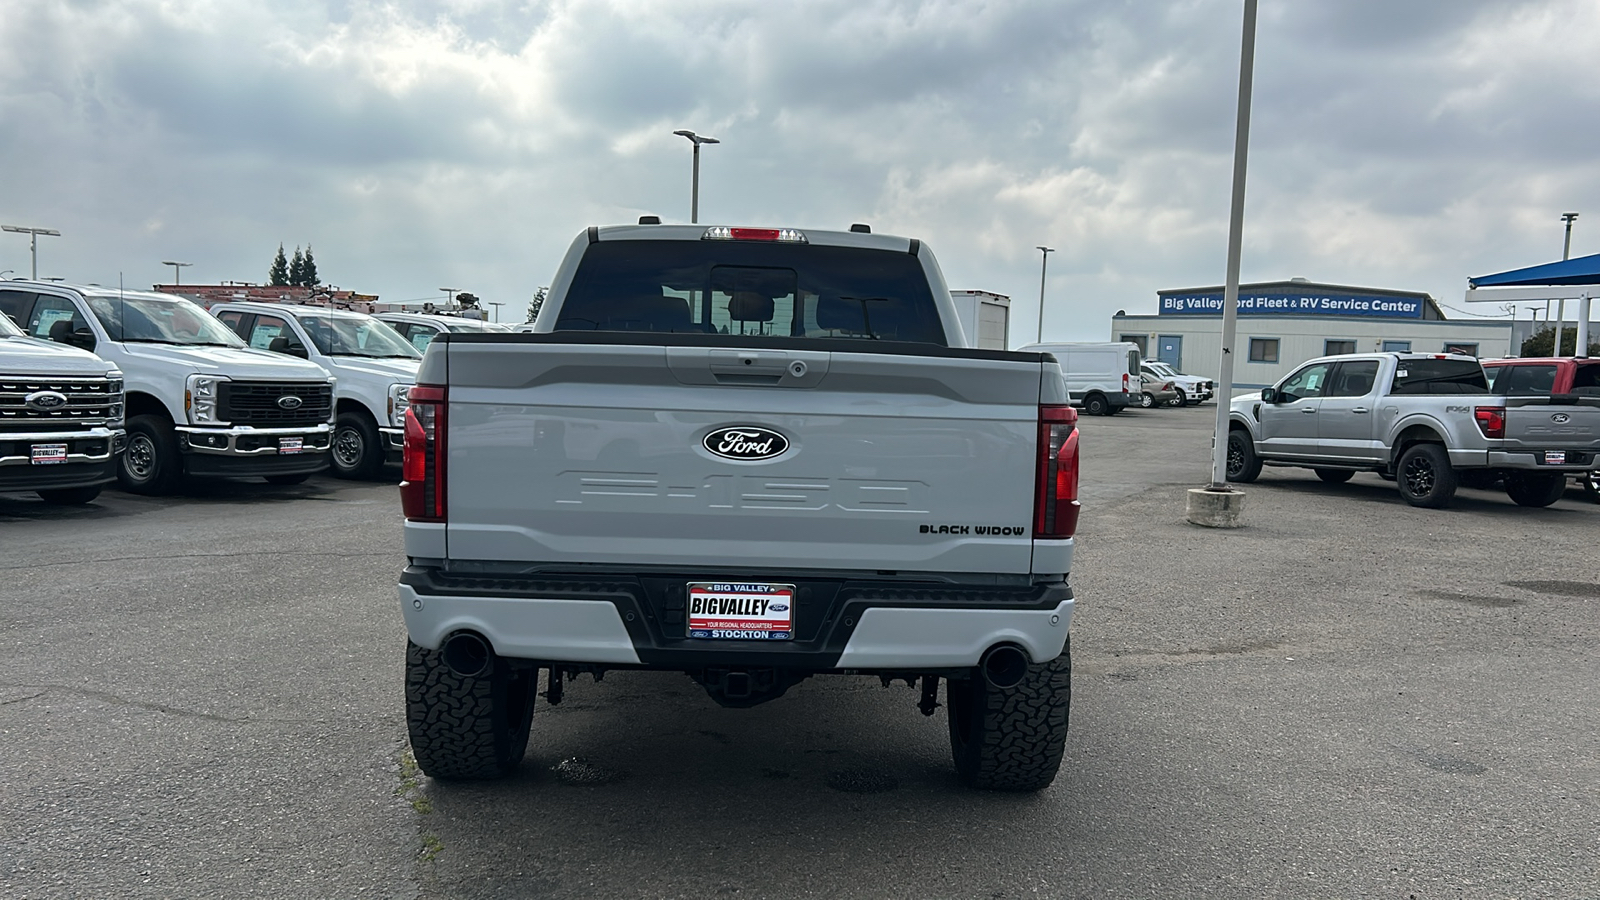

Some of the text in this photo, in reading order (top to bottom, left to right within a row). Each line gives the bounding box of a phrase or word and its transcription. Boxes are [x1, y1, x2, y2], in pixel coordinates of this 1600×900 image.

[1164, 298, 1184, 310] Big
[1186, 298, 1224, 310] Valley
[1236, 297, 1254, 308] ord
[1256, 297, 1288, 308] Fleet
[1300, 298, 1319, 308] RV
[1321, 298, 1369, 310] Service
[1371, 300, 1417, 312] Center
[39, 396, 58, 406] Ford
[718, 430, 774, 455] Ford
[919, 525, 1025, 536] BLACK WIDOW
[690, 597, 770, 616] BIGVALLEY
[712, 630, 769, 639] STOCKTON
